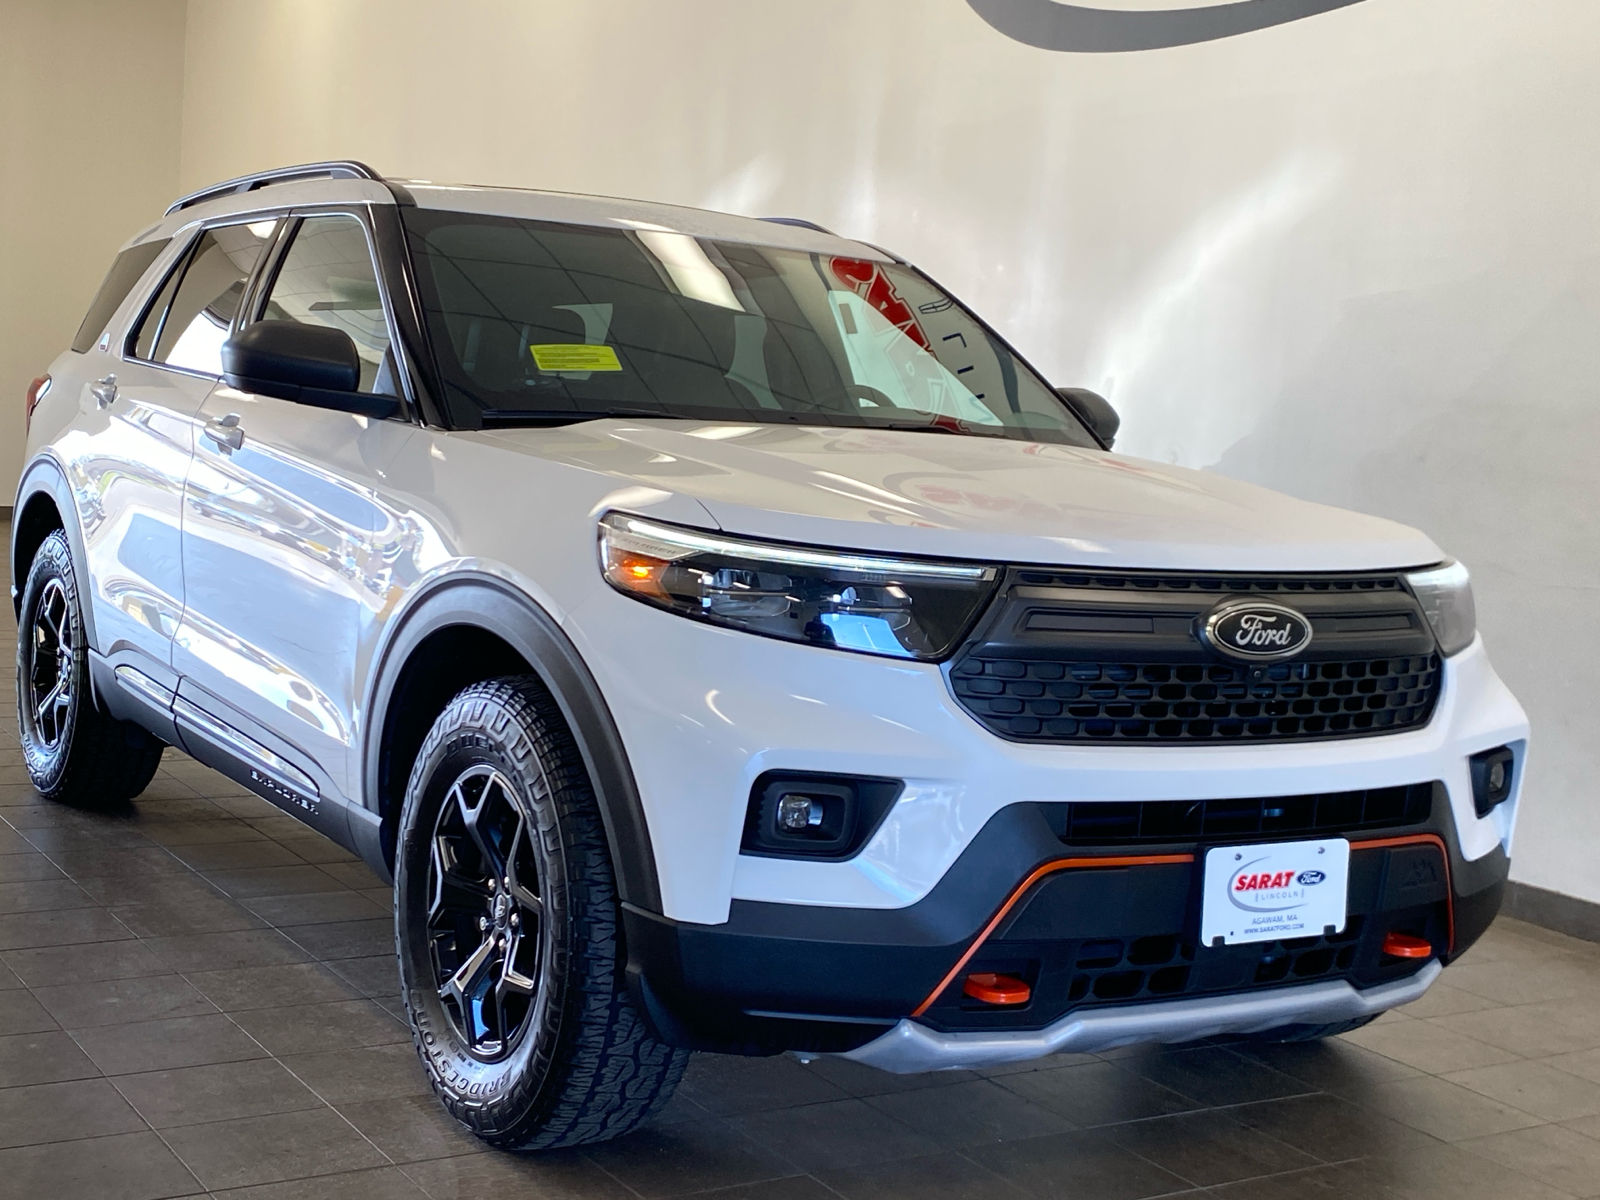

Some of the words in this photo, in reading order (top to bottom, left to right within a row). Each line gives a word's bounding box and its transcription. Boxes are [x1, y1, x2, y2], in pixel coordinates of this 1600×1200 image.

[1235, 614, 1292, 646] Ford
[1234, 870, 1296, 892] SARAT
[1300, 871, 1322, 884] Ford
[1260, 890, 1299, 900] LINCOLN
